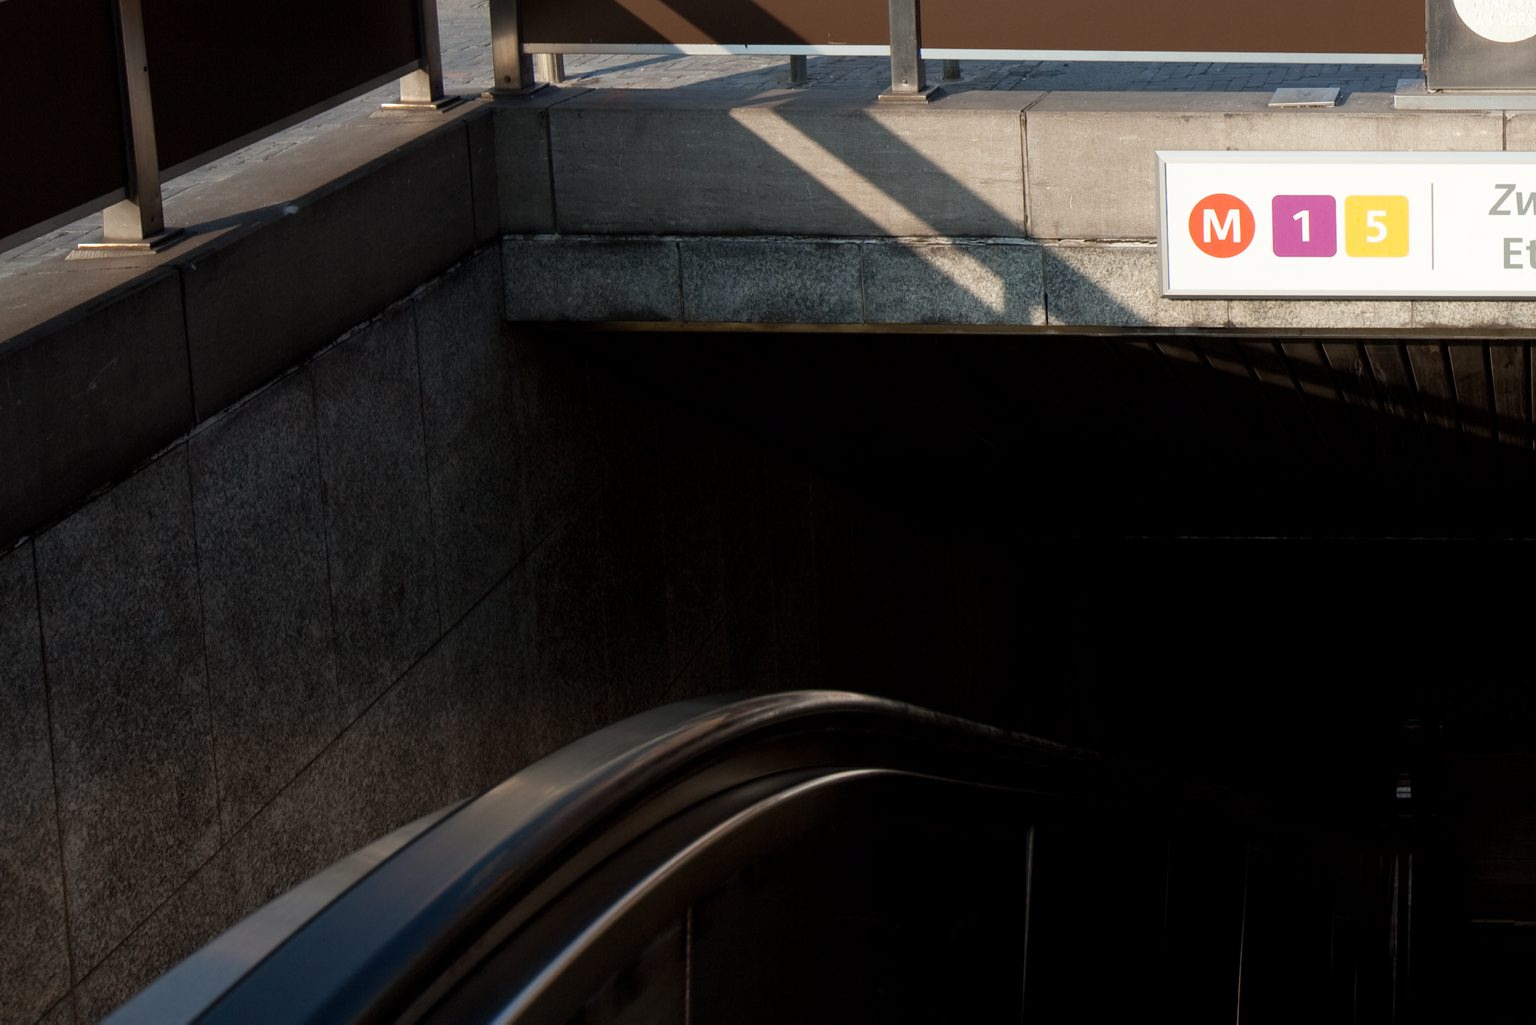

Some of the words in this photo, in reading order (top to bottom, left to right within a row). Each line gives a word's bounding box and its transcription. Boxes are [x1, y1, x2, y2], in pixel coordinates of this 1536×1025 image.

[1202, 208, 1242, 243] M
[1292, 209, 1313, 242] 1
[1365, 209, 1388, 243] 5
